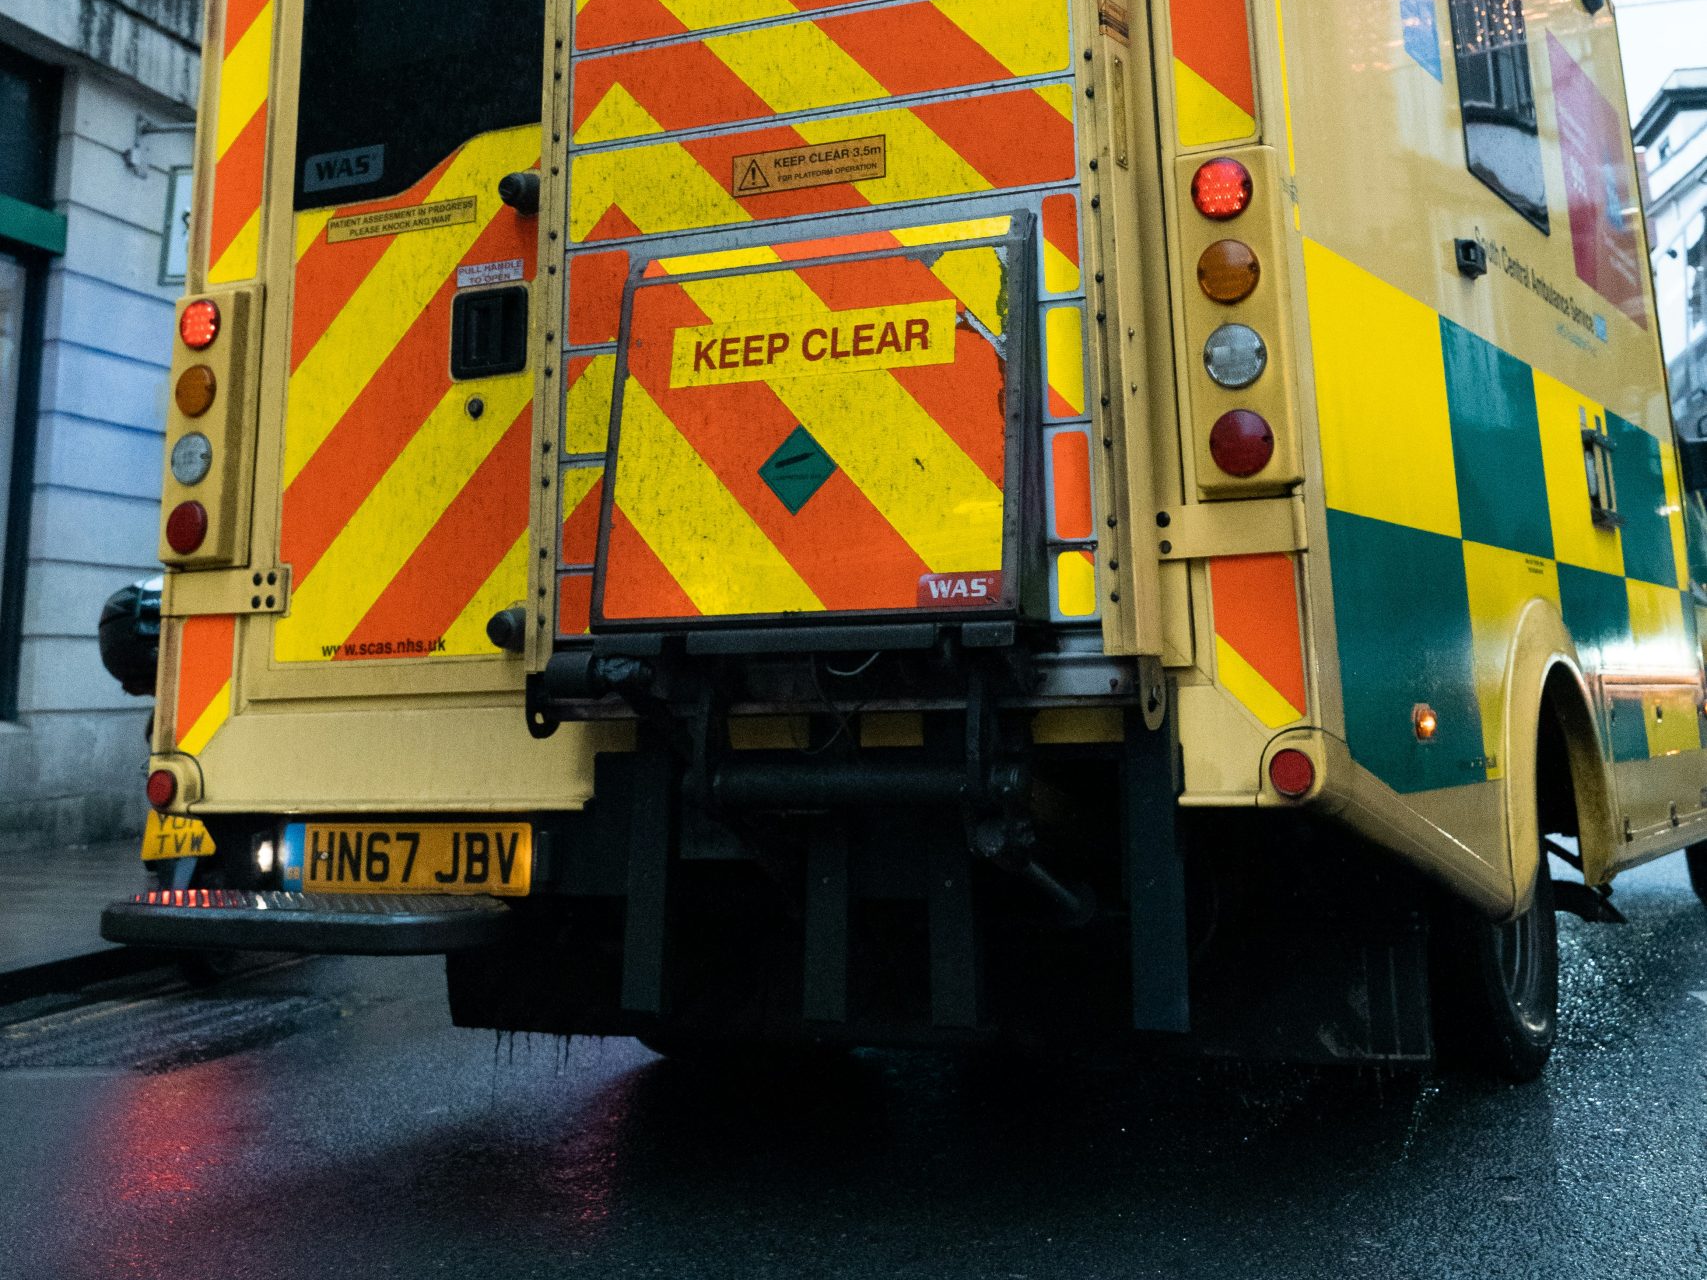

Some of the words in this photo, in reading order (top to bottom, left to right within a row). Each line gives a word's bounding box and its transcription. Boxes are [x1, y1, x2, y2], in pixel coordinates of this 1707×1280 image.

[314, 154, 370, 181] WAS
[774, 155, 806, 169] KEEP
[809, 148, 850, 164] CLEAR
[852, 145, 881, 158] 3.5m
[777, 173, 793, 182] FOR
[795, 168, 833, 181] PLATFORM
[835, 162, 877, 175] OPERATION
[330, 218, 361, 230] PATIENT
[363, 209, 416, 224] ASSESSMENT
[418, 208, 426, 216] IN
[428, 200, 474, 215] PROGRESS
[350, 225, 382, 237] PLEASE
[382, 221, 411, 232] KNOCK
[412, 217, 430, 227] AND
[431, 213, 452, 224] WAIT
[458, 266, 481, 274] PULL
[484, 260, 523, 271] HANDLE
[485, 273, 511, 283] OPEN
[693, 332, 790, 372] KEEP
[801, 318, 930, 363] CLEAR
[928, 577, 987, 599] WAS
[310, 831, 420, 883] HN67
[434, 831, 521, 885] JBV
